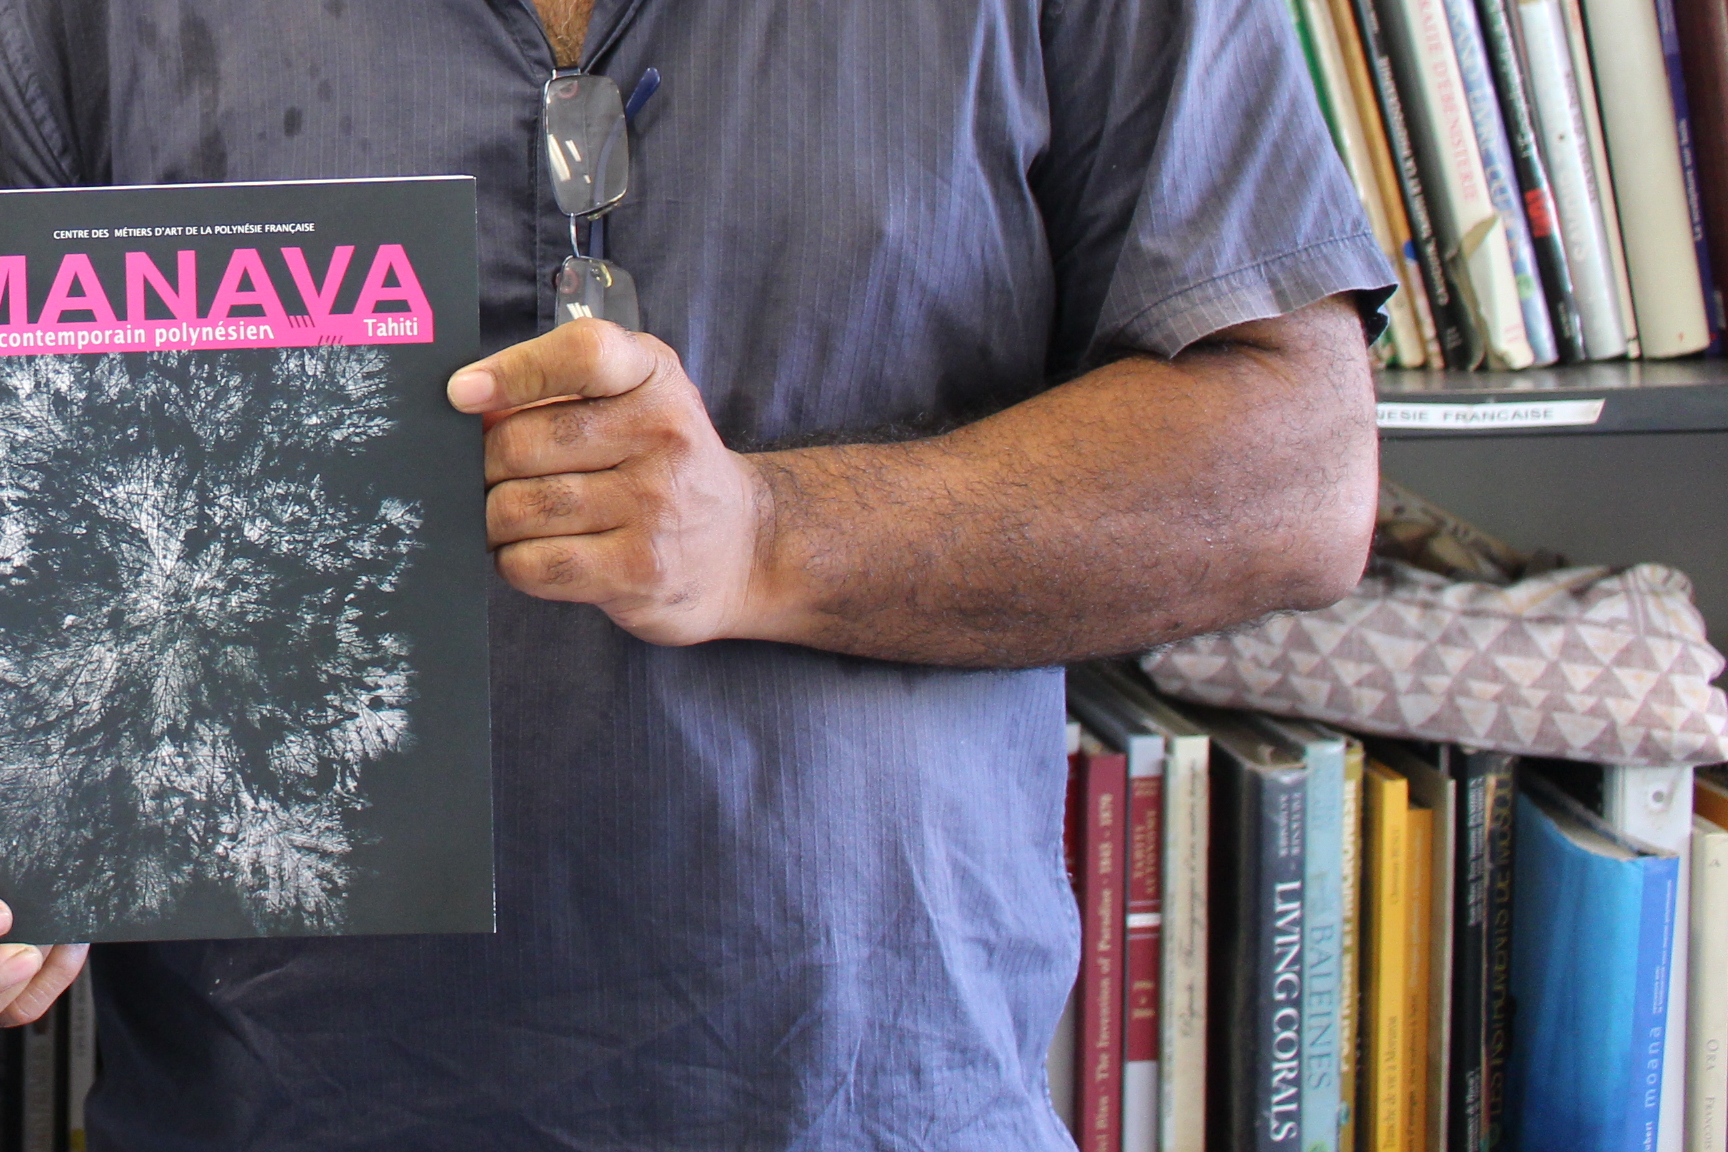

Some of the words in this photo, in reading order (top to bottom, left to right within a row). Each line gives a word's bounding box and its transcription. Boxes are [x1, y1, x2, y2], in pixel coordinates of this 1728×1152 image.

[53, 229, 90, 240] CENTRE
[91, 229, 109, 239] DES
[114, 225, 153, 238] MÉTIERS
[154, 226, 182, 237] D'ART
[185, 226, 199, 236] DE
[200, 225, 212, 236] LA
[214, 223, 263, 235] POLYNÉSIE
[264, 222, 315, 236] FRANÇAISE
[154, 319, 275, 348] polynésien
[364, 316, 419, 338] Tahiti
[1098, 957, 1111, 973] of
[1272, 881, 1302, 1001] LIVING
[1097, 979, 1111, 1047] Invention
[1307, 924, 1335, 1091] BALEINES
[1096, 1053, 1110, 1081] The
[1270, 1007, 1302, 1141] CORALS
[1643, 1026, 1663, 1108] moana
